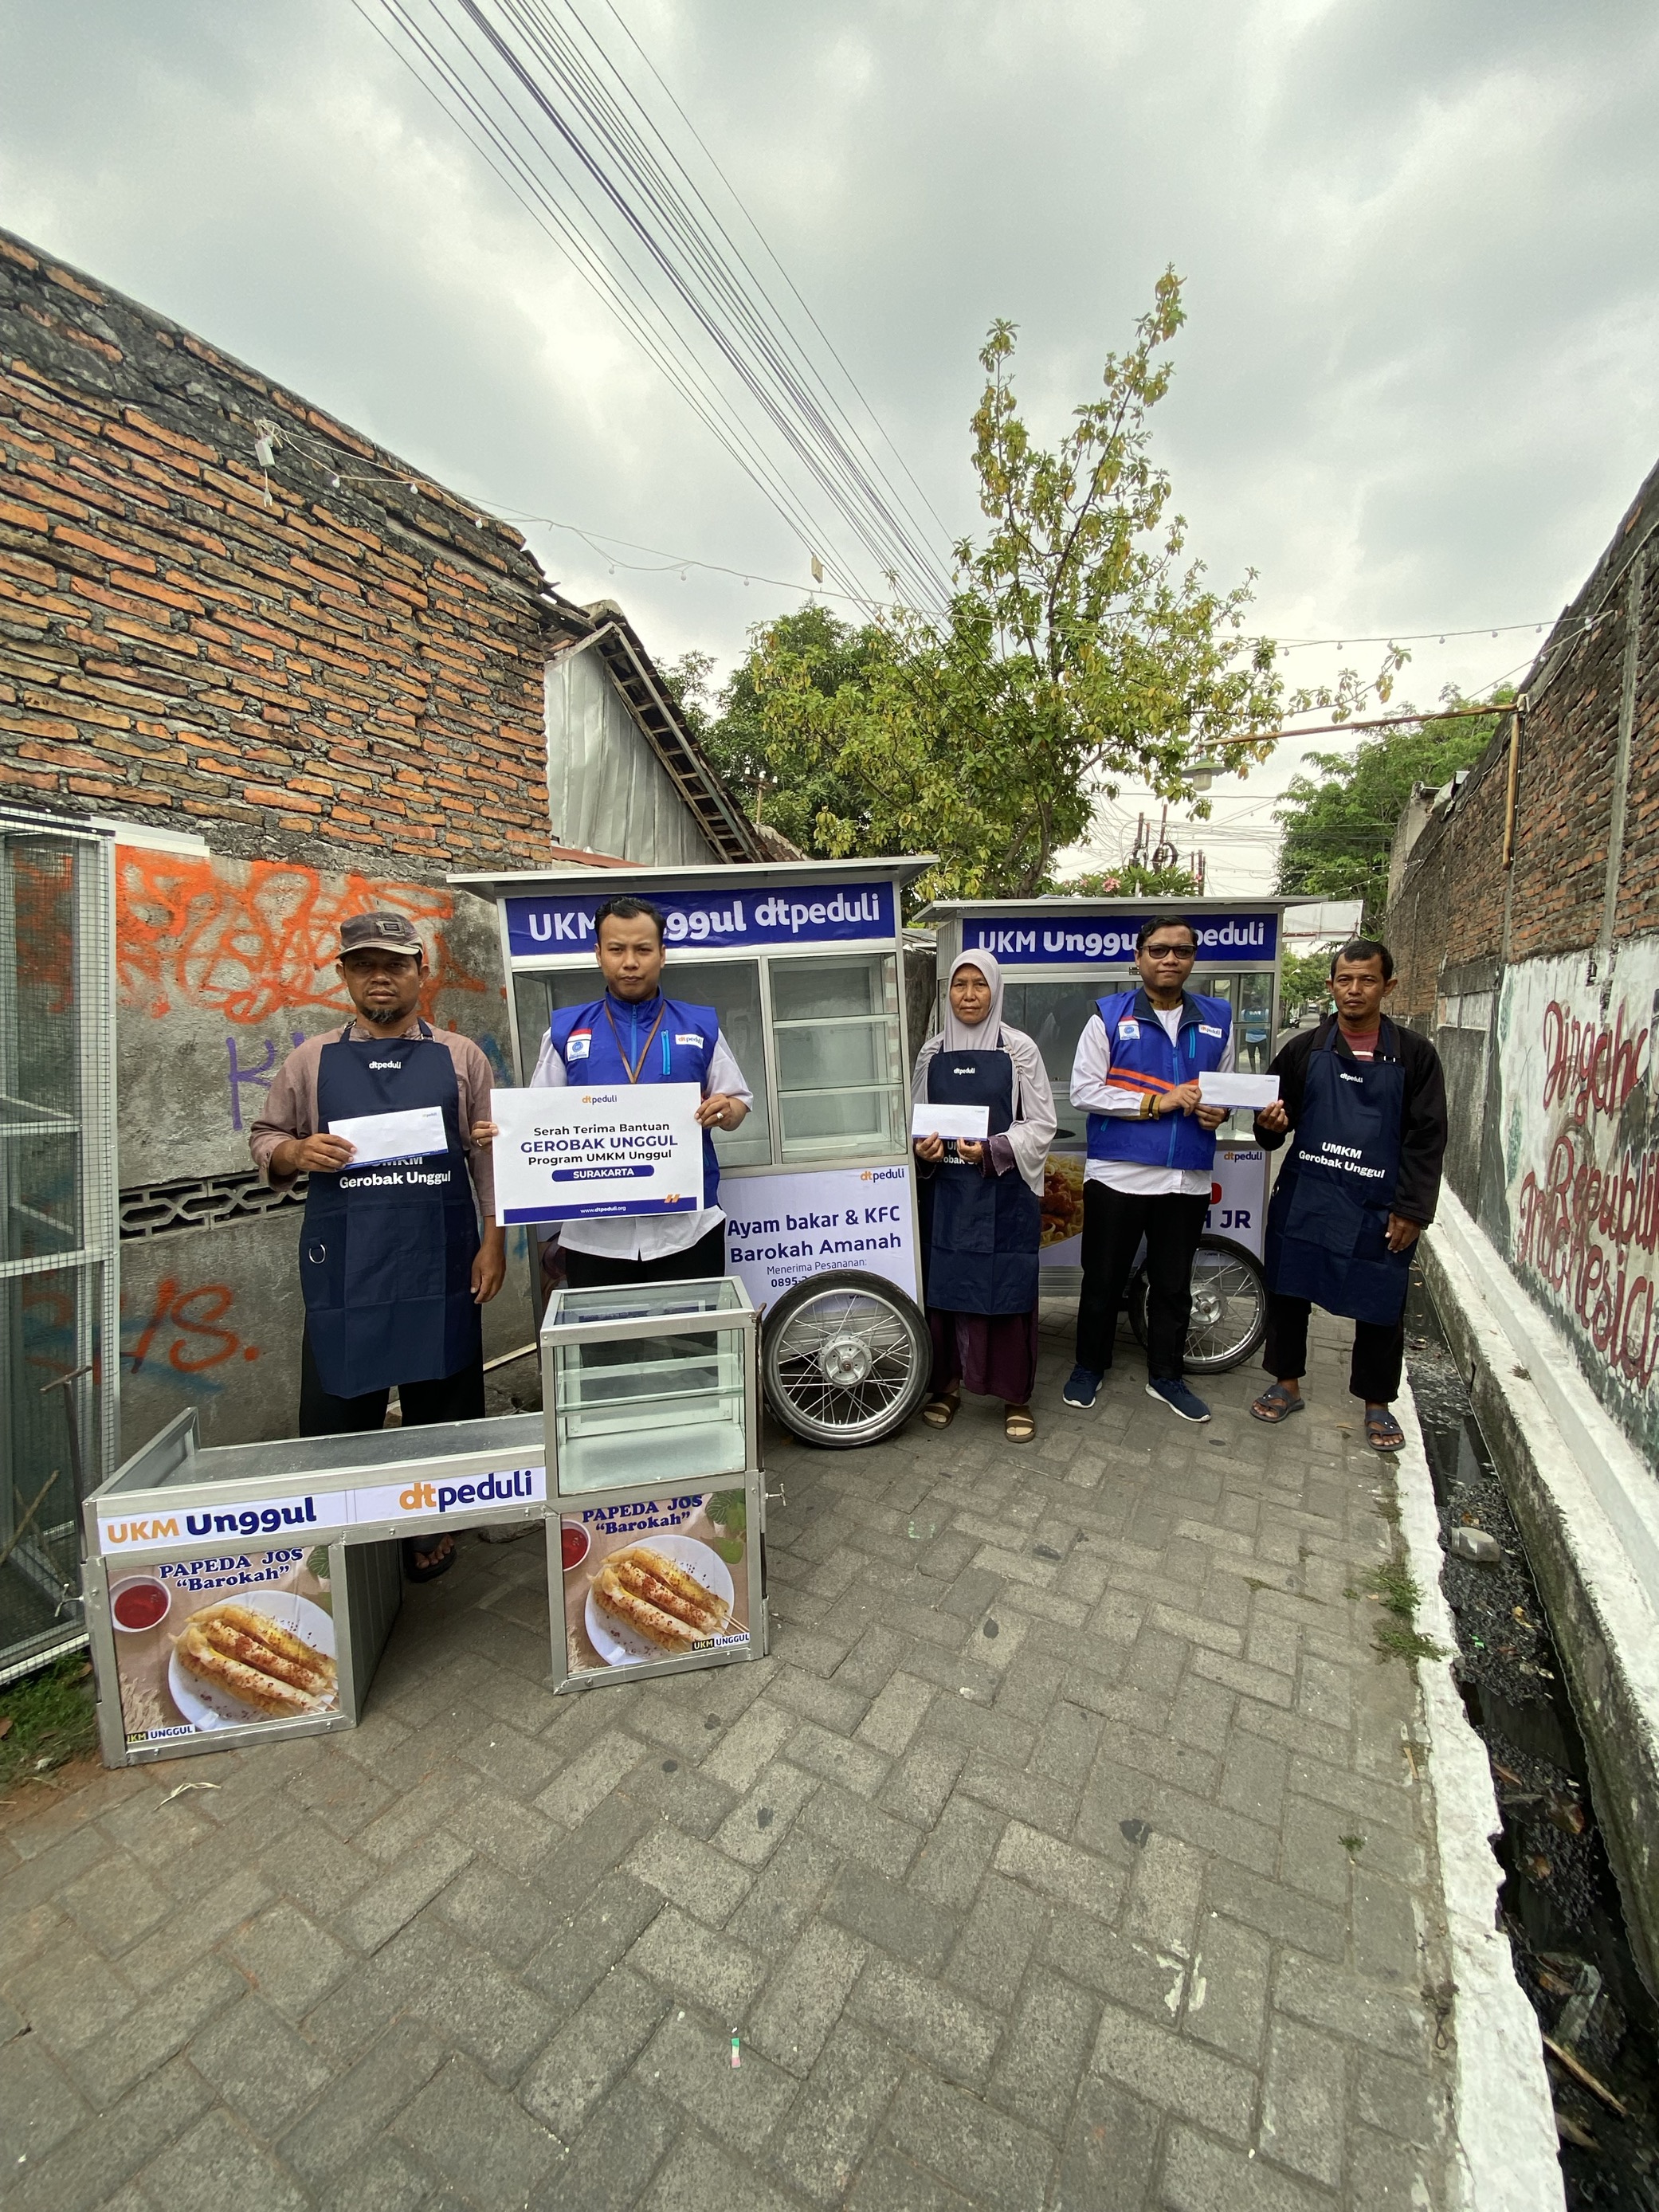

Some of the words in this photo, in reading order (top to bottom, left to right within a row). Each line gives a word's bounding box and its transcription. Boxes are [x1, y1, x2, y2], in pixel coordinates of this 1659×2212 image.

[664, 900, 747, 941] ggul
[755, 892, 880, 934] dtpeduli
[979, 930, 1036, 953] UKM
[1042, 930, 1139, 957] Unggu
[369, 1061, 402, 1070] dtpeduli
[1339, 1073, 1363, 1084] dtpeduli
[582, 1095, 618, 1105] dtpeduli
[534, 1126, 570, 1136] Serah
[573, 1124, 616, 1135] Terima
[619, 1122, 670, 1132] Bantuan
[520, 1138, 606, 1153] GEROBAK
[610, 1135, 678, 1148] UNGGUL
[1322, 1142, 1363, 1159] UMKM
[528, 1155, 582, 1166] Program
[586, 1151, 626, 1163] UMKM
[629, 1150, 672, 1161] Unggul
[1223, 1151, 1262, 1163] dtpeduli
[1298, 1151, 1343, 1169] Gerobak
[1344, 1161, 1386, 1179] Unggul
[339, 1173, 404, 1189] Gerobak
[406, 1170, 451, 1186] Unggul
[573, 1167, 635, 1179] SURAKARTA
[860, 1168, 904, 1182] dtpeduli
[728, 1218, 780, 1239] Ayam
[786, 1212, 839, 1230] bakar
[845, 1209, 859, 1226] &
[865, 1206, 900, 1224] KFC
[1219, 1210, 1252, 1229] JR
[730, 1241, 814, 1263] Barokah
[819, 1233, 902, 1255] Amanah
[767, 1263, 812, 1275] Menerima
[815, 1259, 868, 1272] Pesananan:
[107, 1519, 179, 1544] UKM
[186, 1496, 317, 1536] Unggul
[399, 1470, 532, 1512] dtpeduli
[582, 1500, 660, 1523] PAPEDA
[667, 1495, 703, 1512] JOS
[595, 1511, 691, 1535] “Barokah”
[159, 1555, 252, 1579] PAPEDA
[261, 1548, 304, 1565] JOS
[176, 1565, 290, 1591] “Barokah”
[694, 1640, 714, 1650] UKM
[716, 1634, 750, 1646] UNGGUL
[127, 1732, 147, 1743] KM
[151, 1726, 193, 1739] UNGGUL
